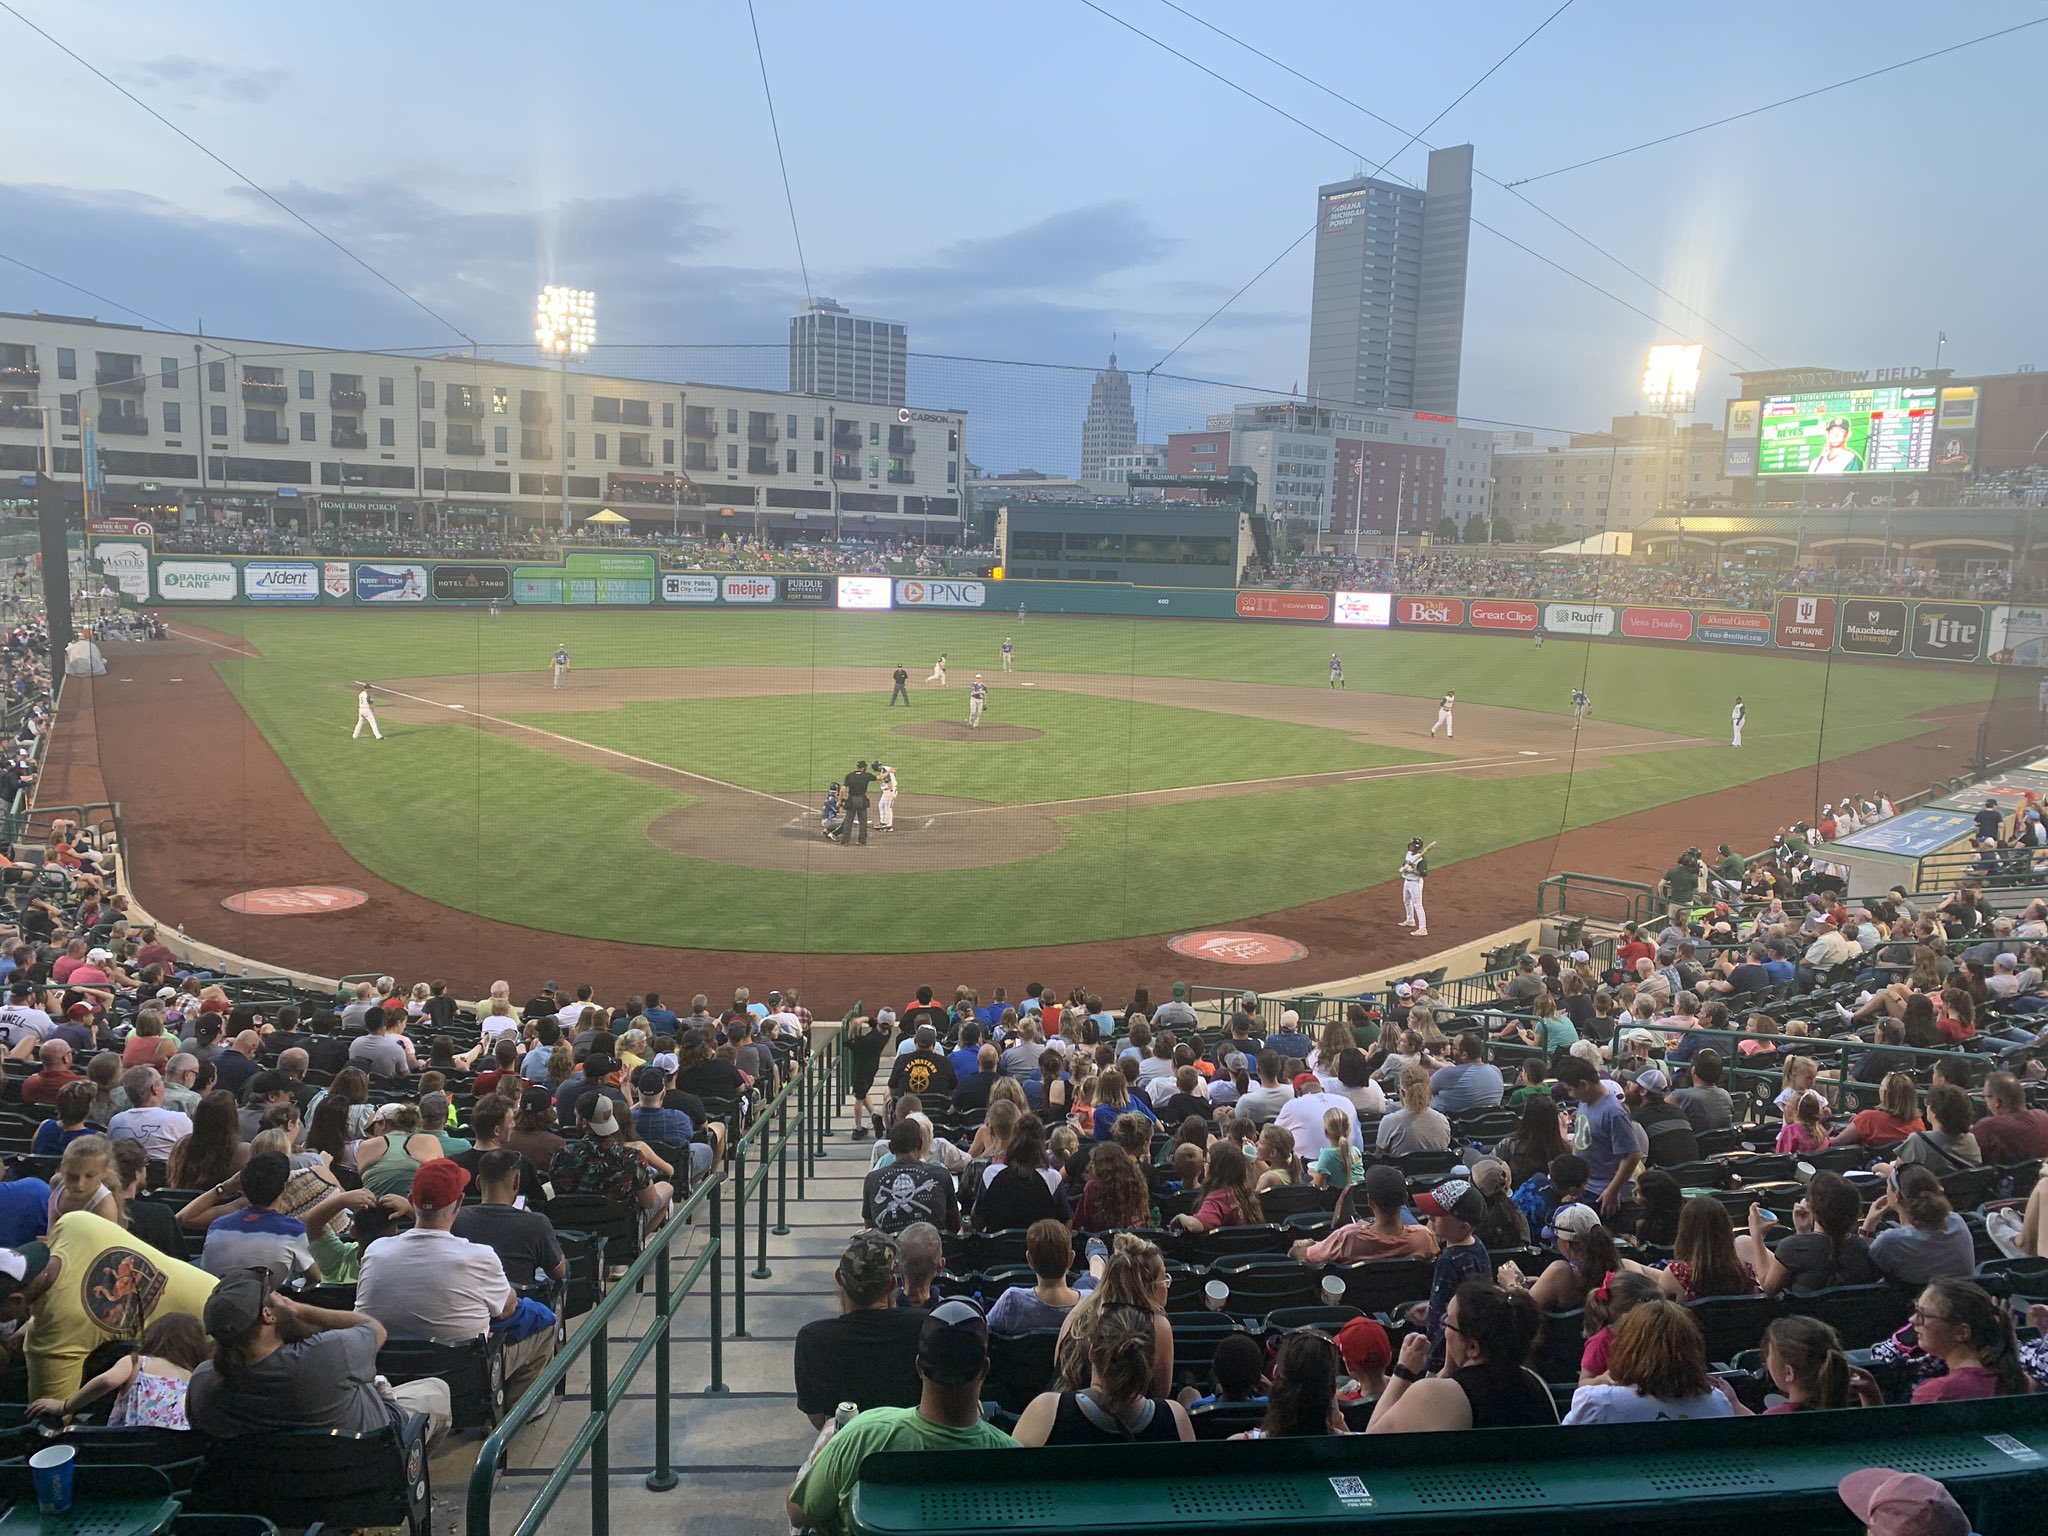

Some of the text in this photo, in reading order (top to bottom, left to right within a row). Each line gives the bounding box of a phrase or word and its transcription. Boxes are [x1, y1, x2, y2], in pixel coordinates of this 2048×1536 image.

[1330, 202, 1361, 213] INDIANA
[1330, 208, 1365, 220] MICHIGAN
[1329, 218, 1353, 227] POWER
[1785, 366, 1922, 387] PARKVIEW FIELD
[911, 413, 949, 423] CARSON
[1777, 429, 1804, 437] REYES
[321, 501, 397, 511] HOME RUN PORCH
[179, 574, 230, 582] BARGAIN
[262, 571, 307, 584] Afdent
[570, 580, 625, 591] PARKVIEW
[728, 580, 770, 598] meijer
[788, 580, 823, 588] PURDUE
[929, 584, 977, 602] PNC
[1242, 597, 1256, 606] GO
[1410, 603, 1450, 622] Best
[1473, 609, 1533, 623] Great Clips
[1572, 612, 1603, 623] Ruoff
[1630, 617, 1684, 631] Vera Bradley
[1707, 615, 1761, 627] Journal Gazette
[1785, 626, 1824, 636] FORT WAYNE
[1847, 625, 1899, 636] Manchester
[1925, 618, 1976, 648] Lite
[1851, 635, 1893, 645] University
